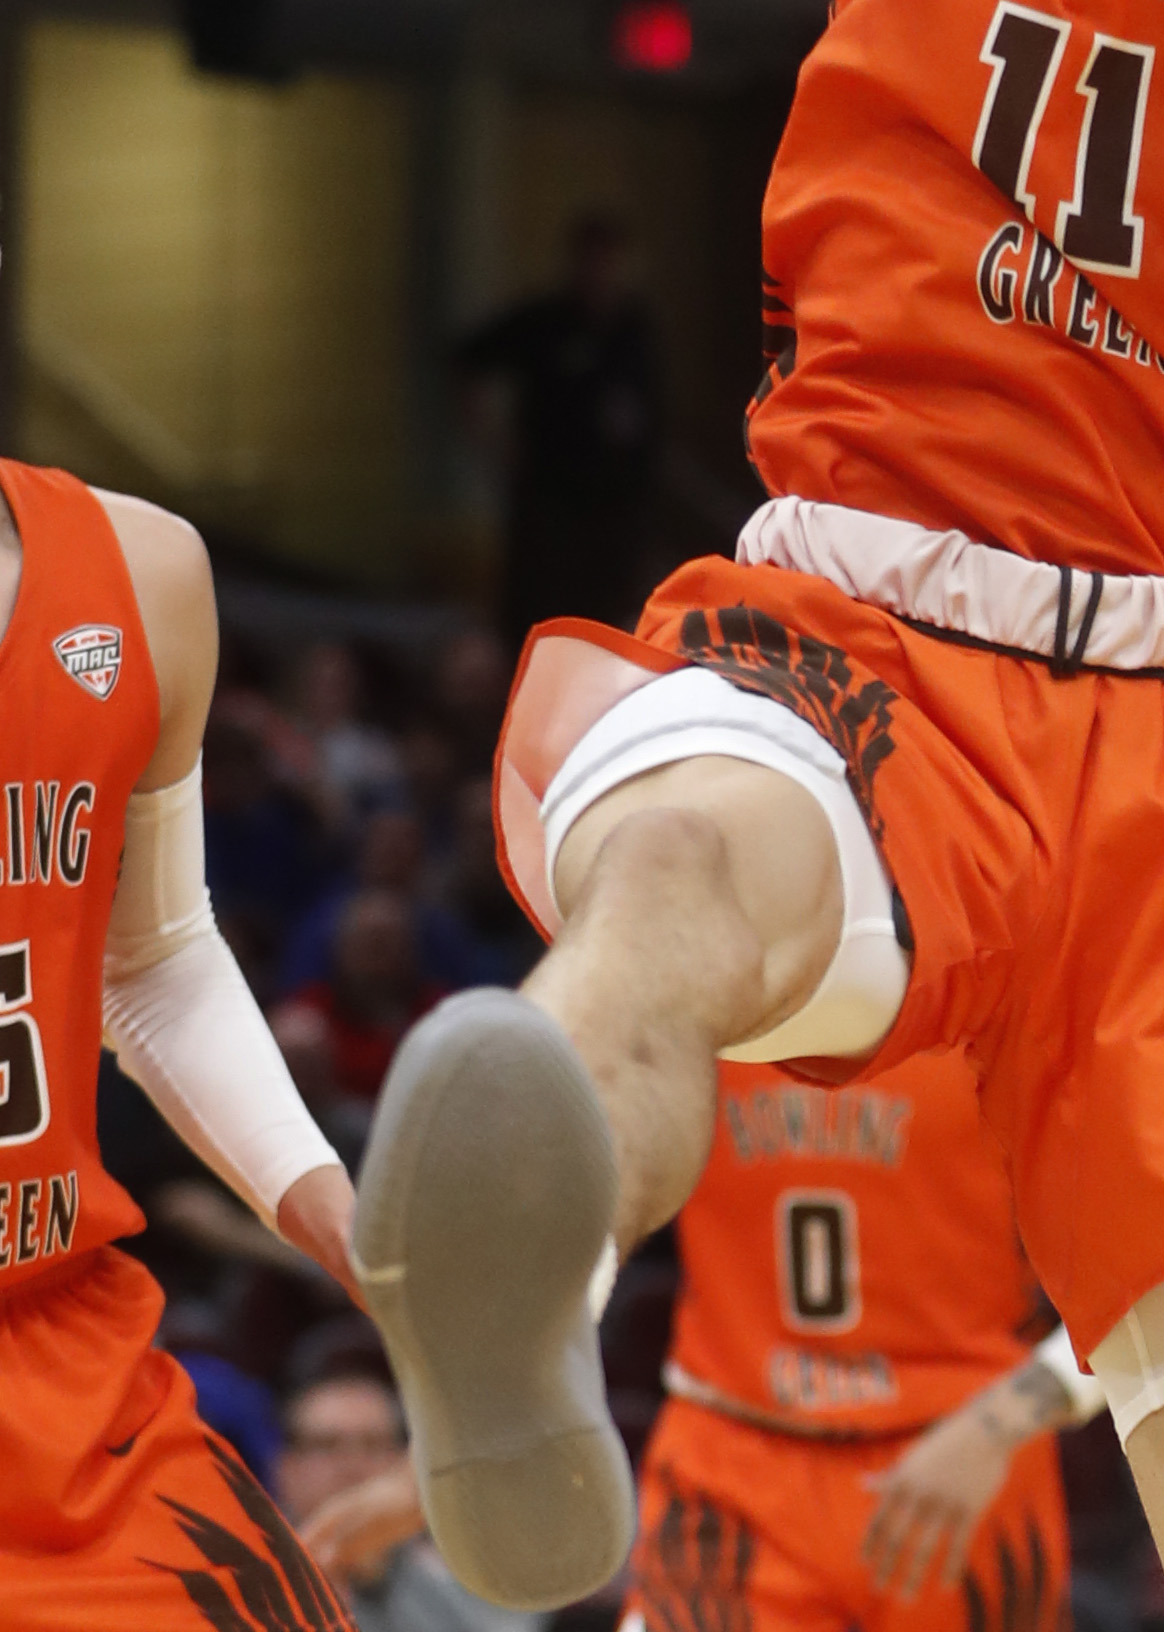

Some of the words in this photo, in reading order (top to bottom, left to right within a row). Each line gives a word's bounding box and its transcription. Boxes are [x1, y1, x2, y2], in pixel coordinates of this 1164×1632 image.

[972, 0, 1155, 279] 11
[65, 645, 121, 674] MAC
[0, 780, 96, 887] ING
[773, 1187, 863, 1336] 0
